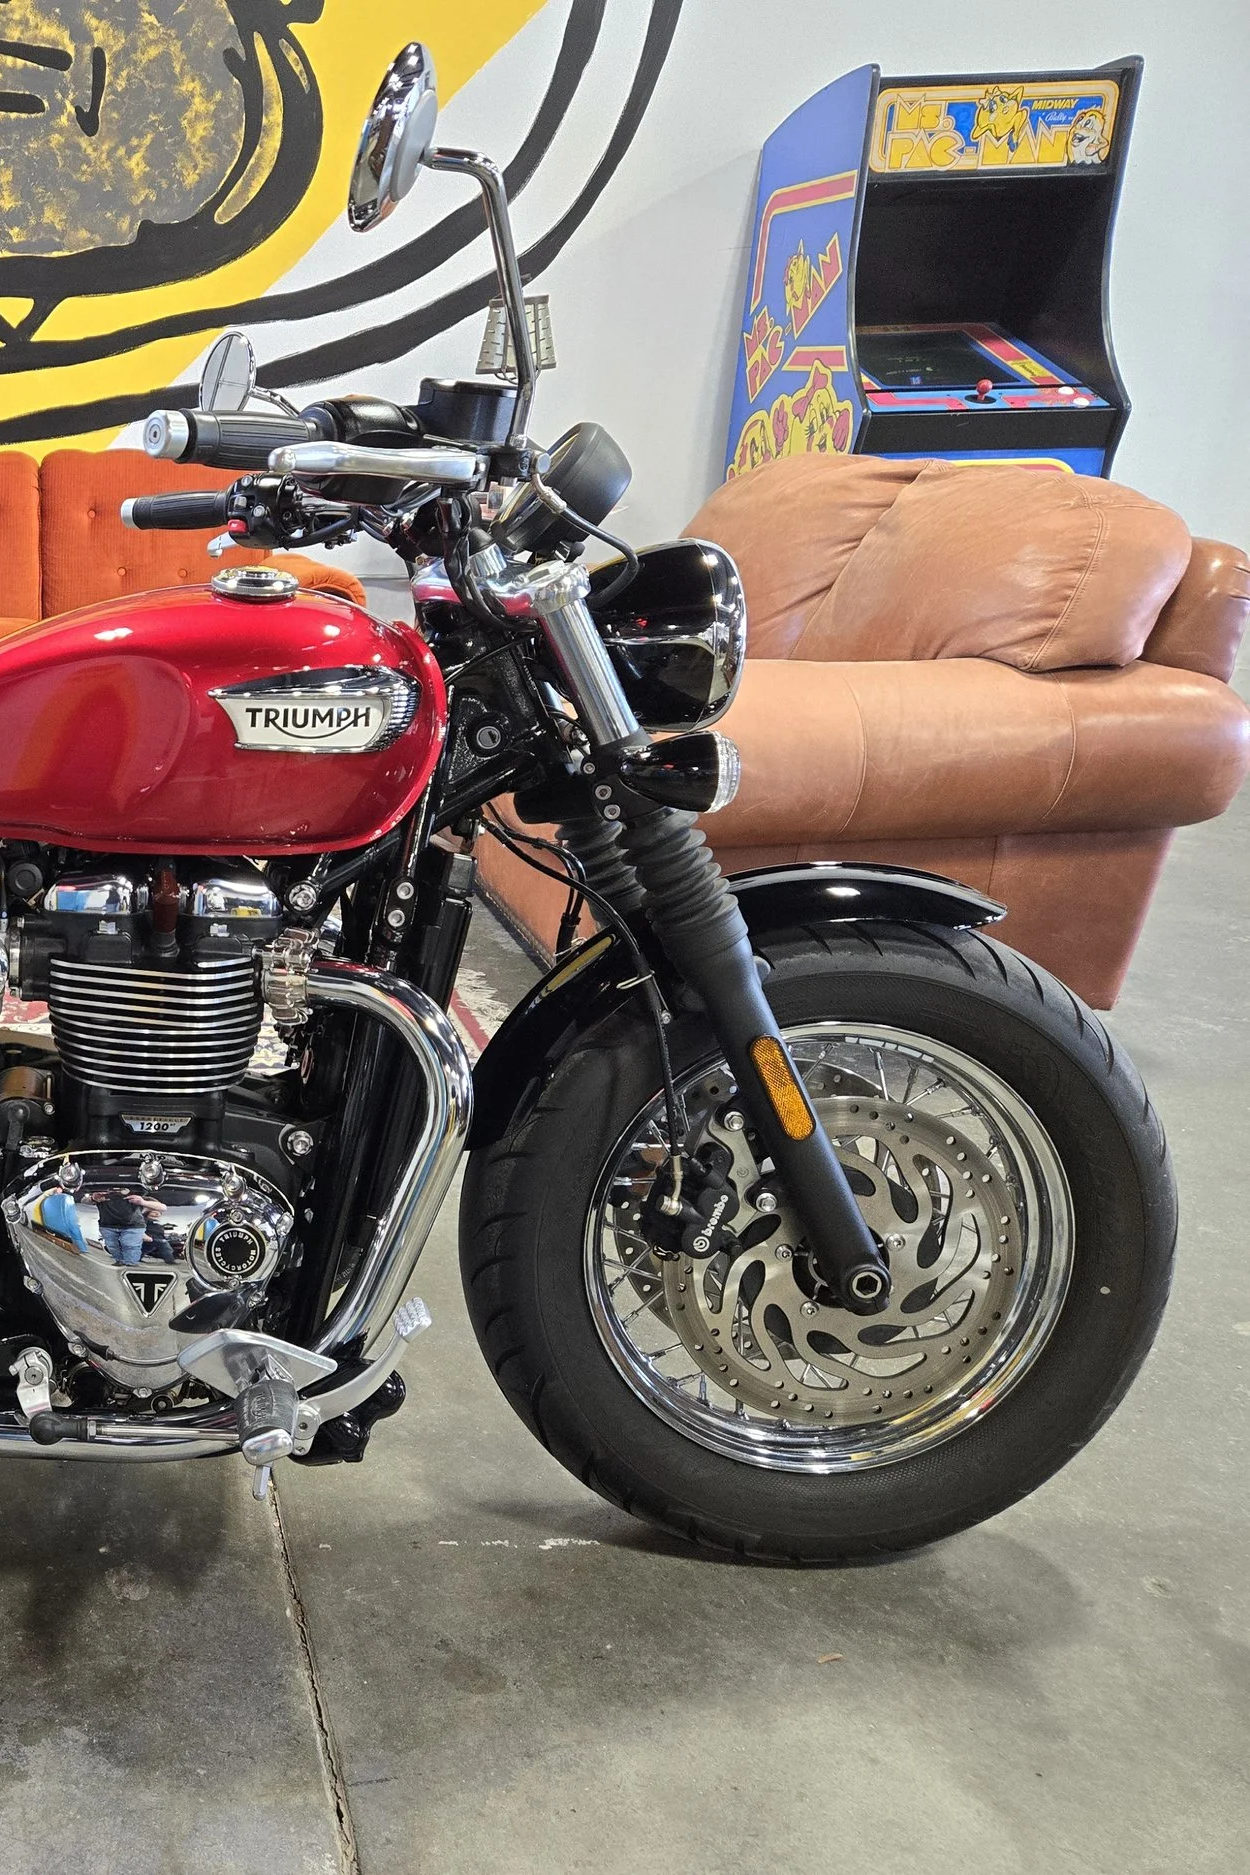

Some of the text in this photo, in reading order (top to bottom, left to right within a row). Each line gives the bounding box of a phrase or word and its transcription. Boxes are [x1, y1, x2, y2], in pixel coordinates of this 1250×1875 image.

[1032, 98, 1078, 110] MIDWAY
[886, 116, 1069, 172] PAC-MAN
[245, 707, 371, 739] TRIUMPH
[140, 1122, 169, 1131] 1200
[701, 1194, 729, 1237] brembo
[215, 1231, 257, 1271] TRIUMPH MOTORCYCLES
